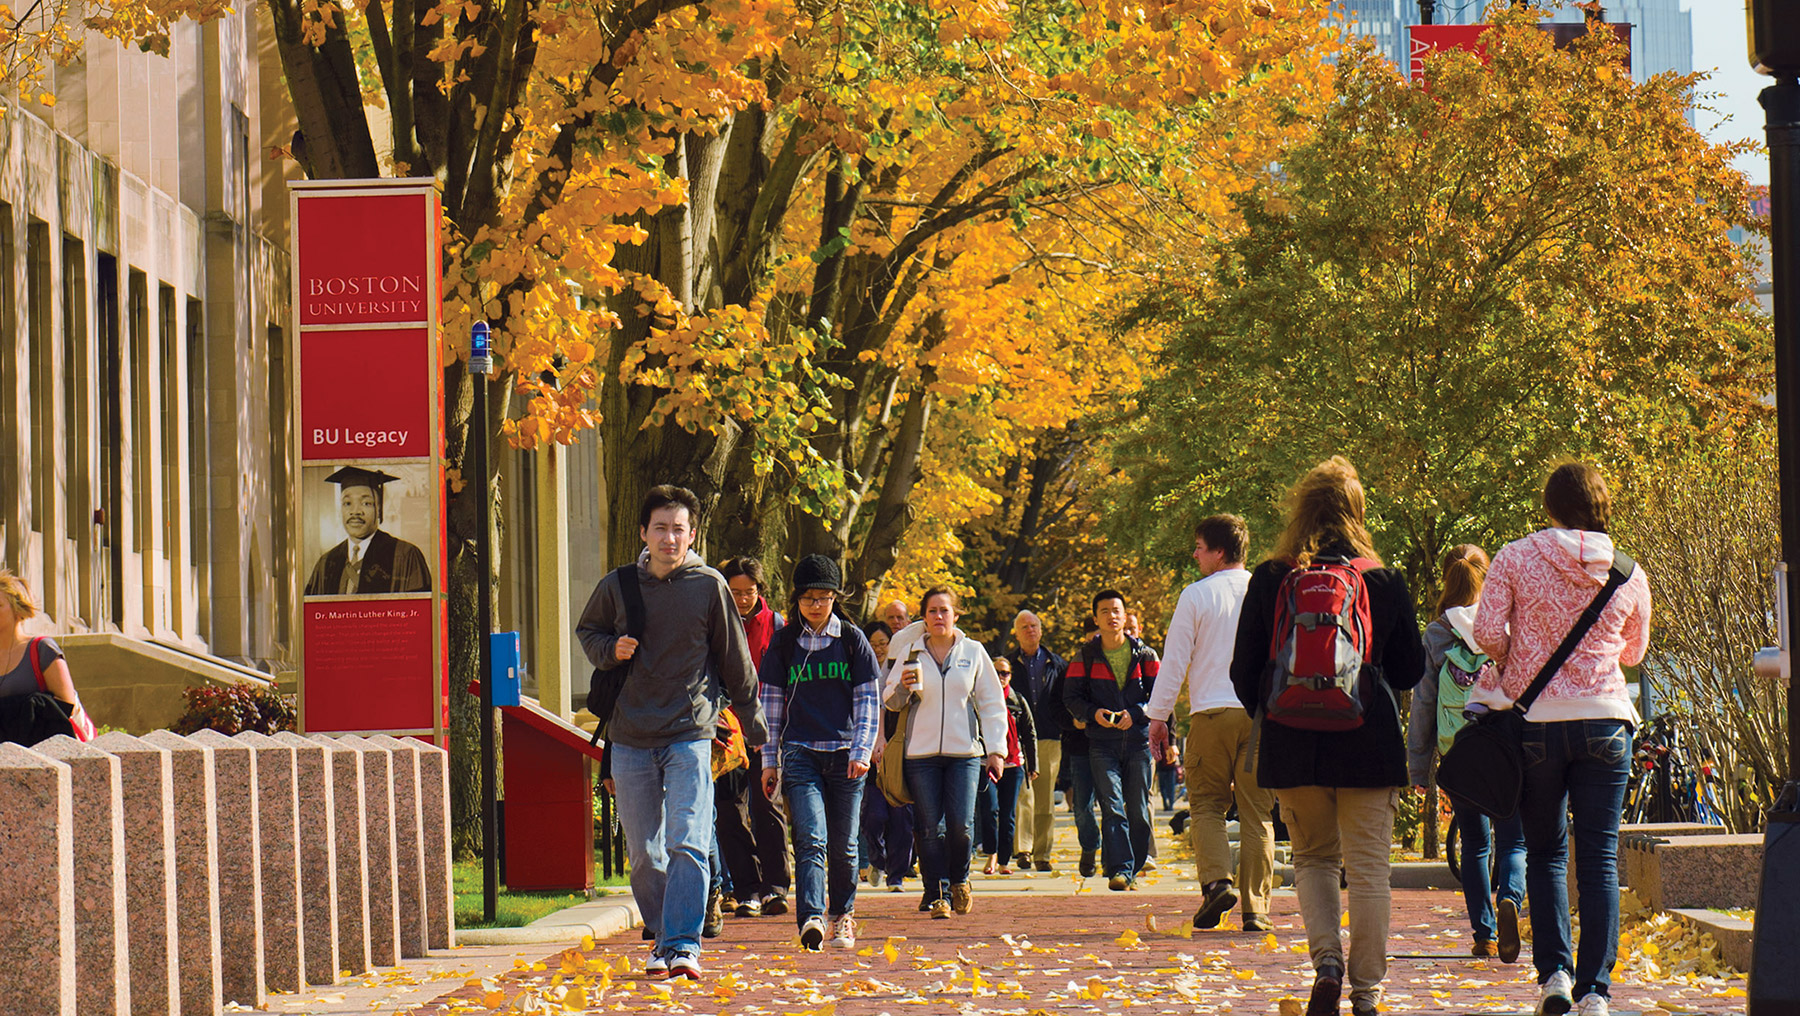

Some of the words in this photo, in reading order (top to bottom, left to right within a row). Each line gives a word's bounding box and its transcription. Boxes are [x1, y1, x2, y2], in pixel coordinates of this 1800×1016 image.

[309, 275, 421, 296] BOSTON
[309, 300, 421, 316] UNIVERSITY
[313, 428, 339, 445] BU
[345, 428, 408, 447] Legacy
[315, 612, 328, 620] Dr.
[329, 611, 357, 619] Martin
[359, 610, 385, 618] Luther
[411, 609, 420, 617] Jr.
[787, 663, 813, 686] ALI
